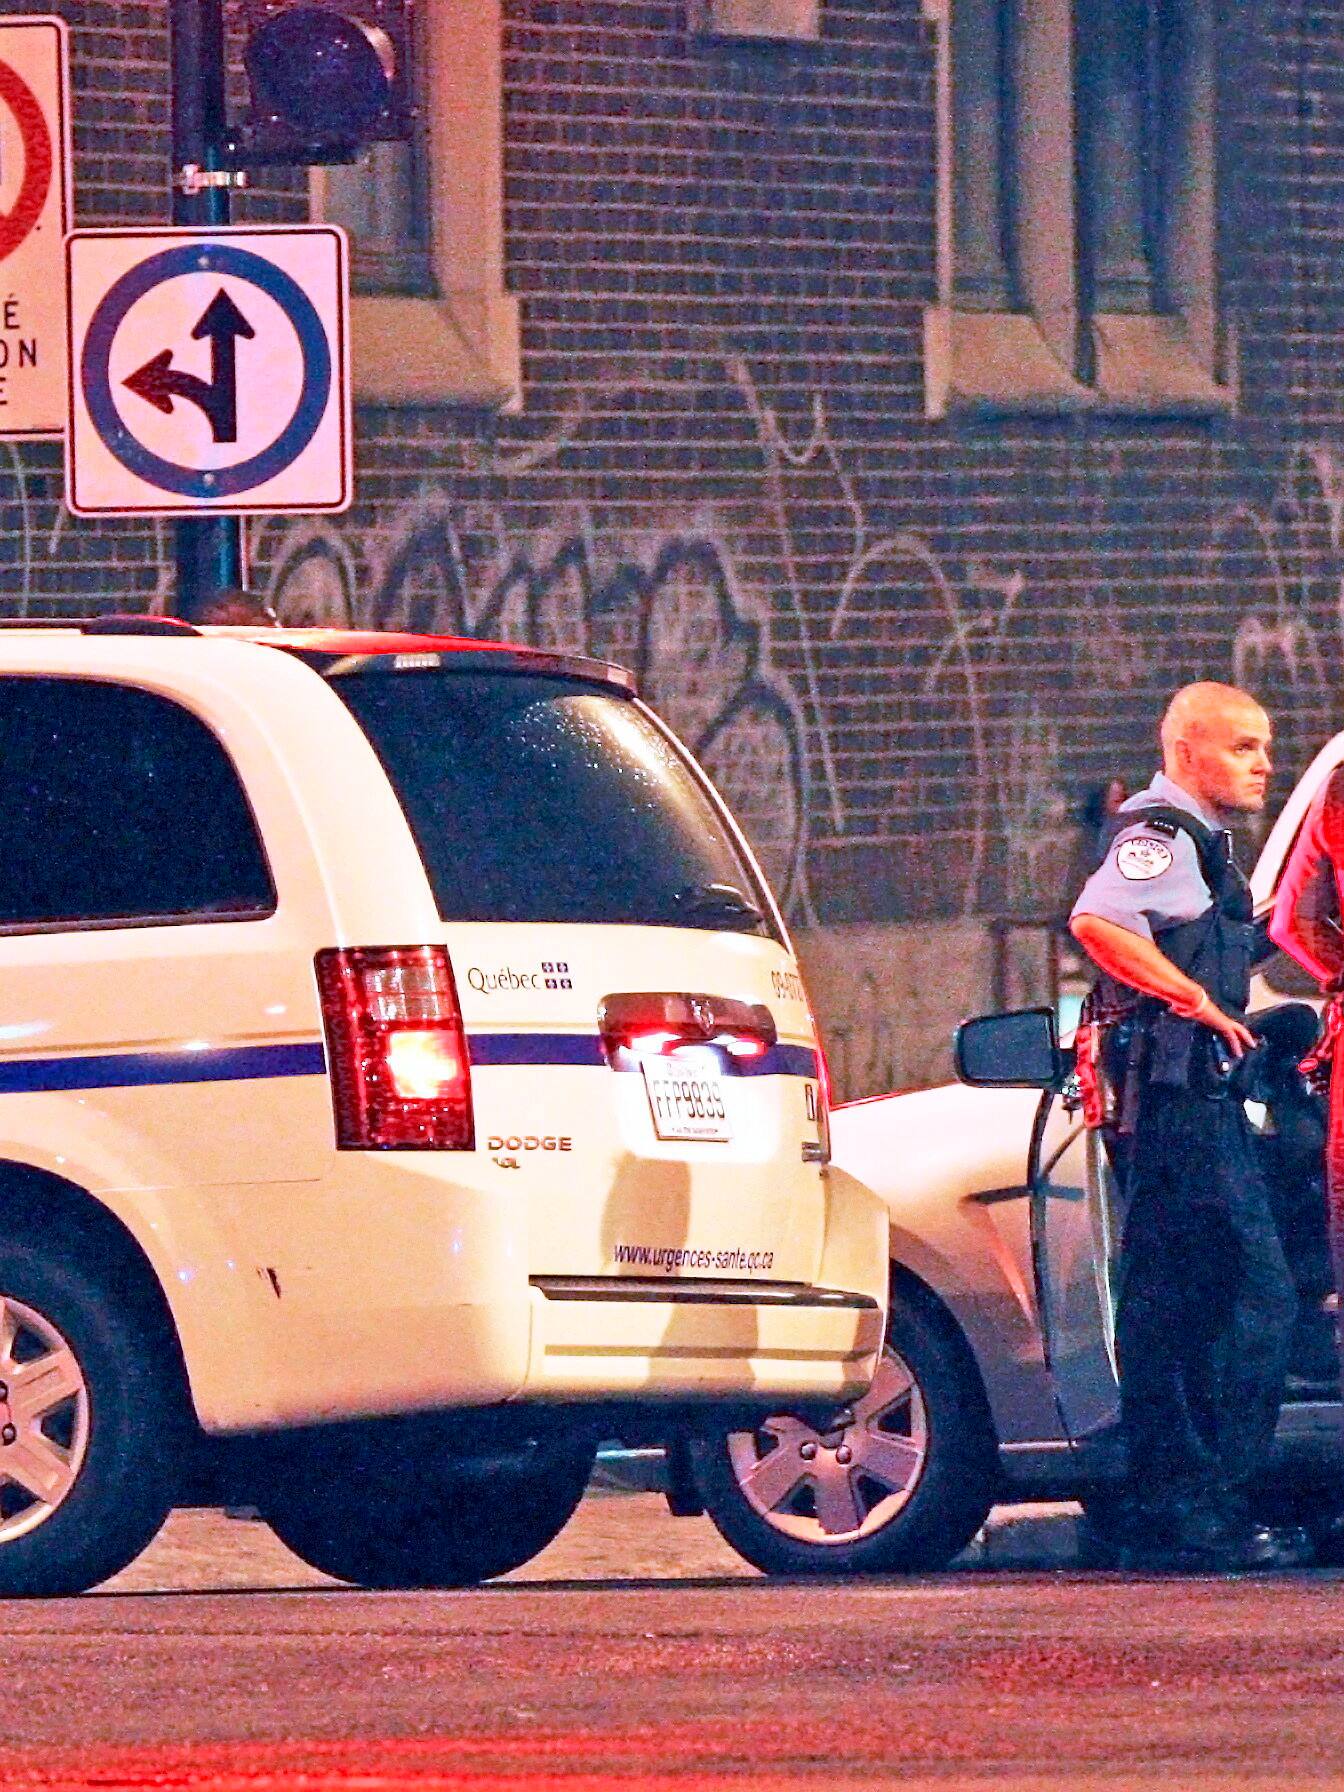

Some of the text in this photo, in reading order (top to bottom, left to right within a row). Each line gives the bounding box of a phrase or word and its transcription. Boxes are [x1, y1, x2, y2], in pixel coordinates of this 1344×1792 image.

[467, 966, 541, 995] Québec
[487, 1135, 572, 1152] DODGE
[614, 1244, 774, 1275] www.urgences-sante.qc.ca
